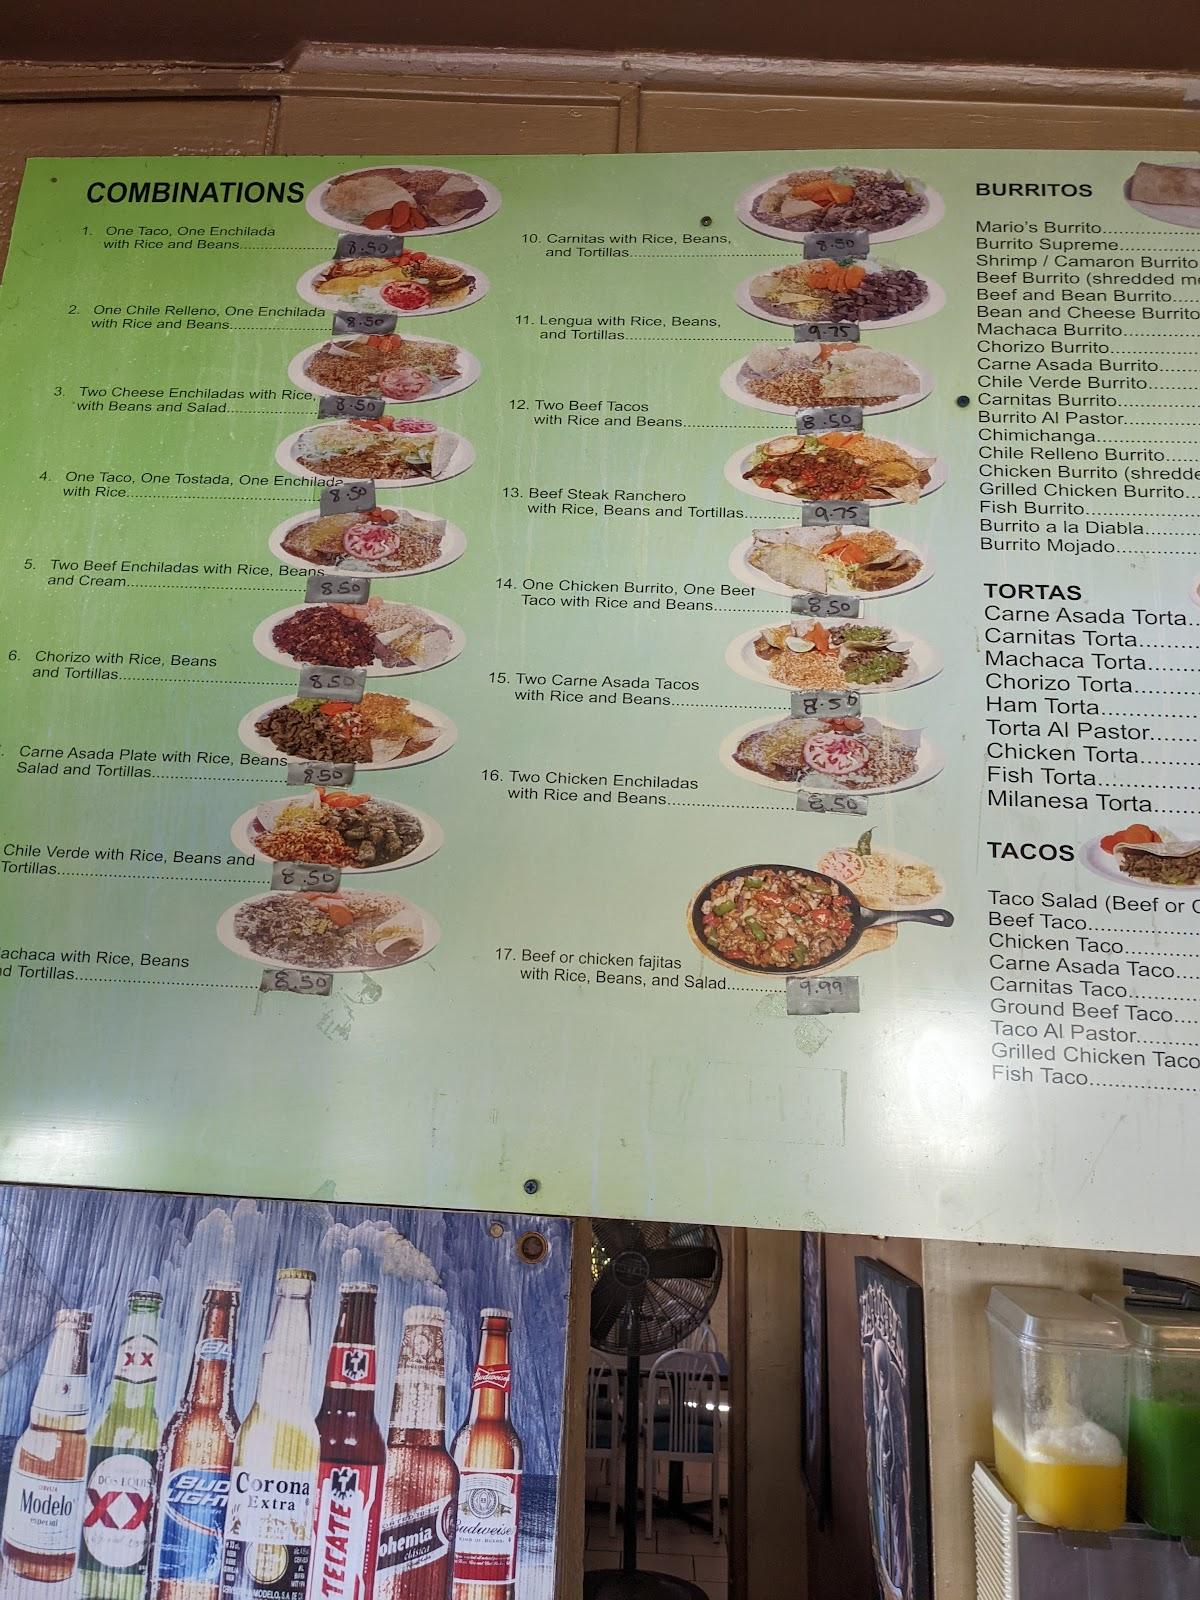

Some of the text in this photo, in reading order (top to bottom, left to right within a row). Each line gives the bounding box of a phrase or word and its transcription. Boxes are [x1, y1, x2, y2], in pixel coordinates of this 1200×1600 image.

[87, 181, 304, 203] COMBINATIONS
[976, 183, 1092, 197] BURRITOS
[83, 226, 275, 237] 1. One Taco, One Enchilada
[522, 233, 731, 245] 10. Carnitas with Rice, Beans,
[103, 239, 130, 249] with
[134, 239, 164, 249] Rice
[167, 239, 193, 249] and
[976, 237, 1033, 250] Burrito
[976, 254, 1037, 270] Shrimp
[1054, 255, 1134, 268] Camaron
[1141, 256, 1198, 269] Burrito
[68, 304, 326, 317] 2. One Chile Relleno, One Enchilada
[516, 315, 721, 328] 11. Lengua with Rice, Beans,
[977, 322, 1057, 336] Machaca
[54, 386, 316, 402] 3. Two Cheese Enchiladas with Rice,
[510, 399, 649, 412] 12. Two Beef Tacos
[503, 487, 686, 502] 13. Beef Steak Ranchero
[979, 482, 1037, 496] Grilled
[1044, 483, 1117, 497] Chicken
[980, 518, 1040, 533] Burrito
[1046, 523, 1057, 533] a
[1063, 520, 1079, 534] la
[981, 537, 1041, 551] Burrito
[496, 578, 516, 589] 14.
[522, 578, 554, 591] One
[559, 579, 619, 592] Chicken
[624, 581, 678, 596] Burrito,
[683, 583, 715, 596] One
[983, 583, 1082, 601] TORTAS
[985, 605, 1049, 622] Carne
[1056, 607, 1125, 624] Asada
[8, 650, 217, 667] 6. Chorizo with Rice, Beans
[489, 672, 699, 691] 15. Two Carne Asada Tacos
[987, 696, 1037, 713] Ham
[19, 745, 288, 767] Carne Asada Plate with Rice, Beans
[482, 769, 698, 790] 16. Two Chicken Enchiladas
[988, 789, 1088, 810] Milanesa
[3, 843, 256, 866] Chile Verde with Rice, Beans and
[987, 842, 1075, 862] TACOS
[988, 890, 1185, 914] Taco Salad (Beef or
[496, 948, 682, 971] 17. Beef or chicken fajitas
[520, 967, 549, 980] with
[554, 968, 590, 984] Rice,
[596, 970, 646, 987] Beans,
[651, 974, 679, 987] and
[991, 998, 1064, 1016] Ground
[1072, 1002, 1119, 1019] Beef
[990, 1020, 1038, 1038] Taco
[1043, 1023, 1063, 1039] Al
[993, 1065, 1033, 1082] Fish
[176, 1476, 231, 1493] BUD
[236, 1471, 310, 1496] Corona
[20, 1488, 73, 1516] Modelo
[249, 1495, 295, 1511] Extra
[321, 1499, 352, 1598] TECATE
[379, 1526, 433, 1557] ohemia
